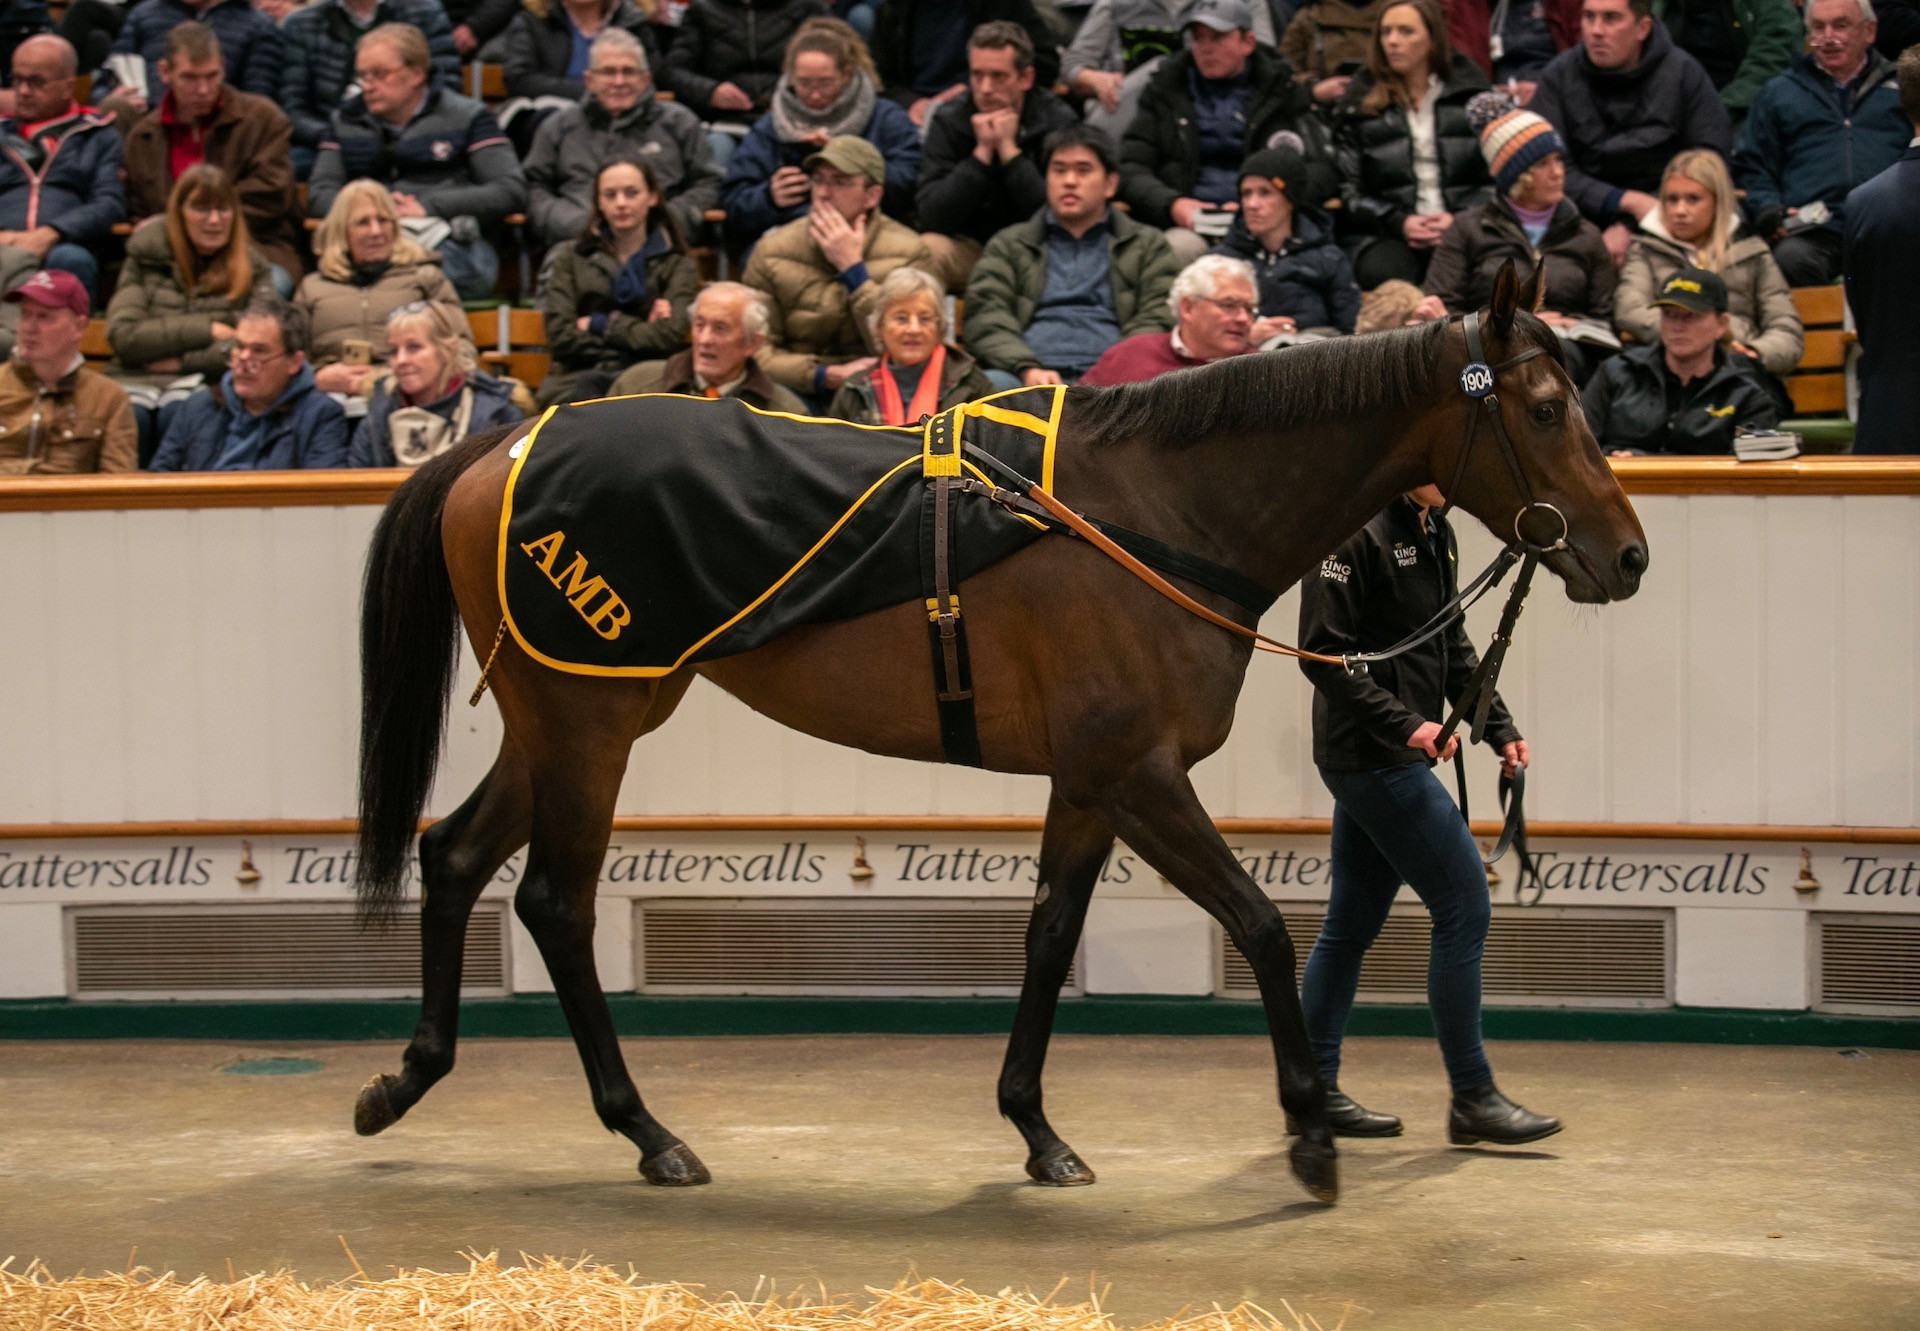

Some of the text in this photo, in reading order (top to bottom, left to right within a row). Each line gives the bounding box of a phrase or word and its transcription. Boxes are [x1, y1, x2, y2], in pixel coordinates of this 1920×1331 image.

[1461, 369, 1493, 392] 1904
[1393, 545, 1417, 559] KING
[1320, 559, 1352, 576] KING
[1397, 556, 1418, 568] POWER
[520, 530, 631, 640] AMB
[1319, 569, 1349, 584] POWER
[1523, 851, 1770, 895] Tattersalls
